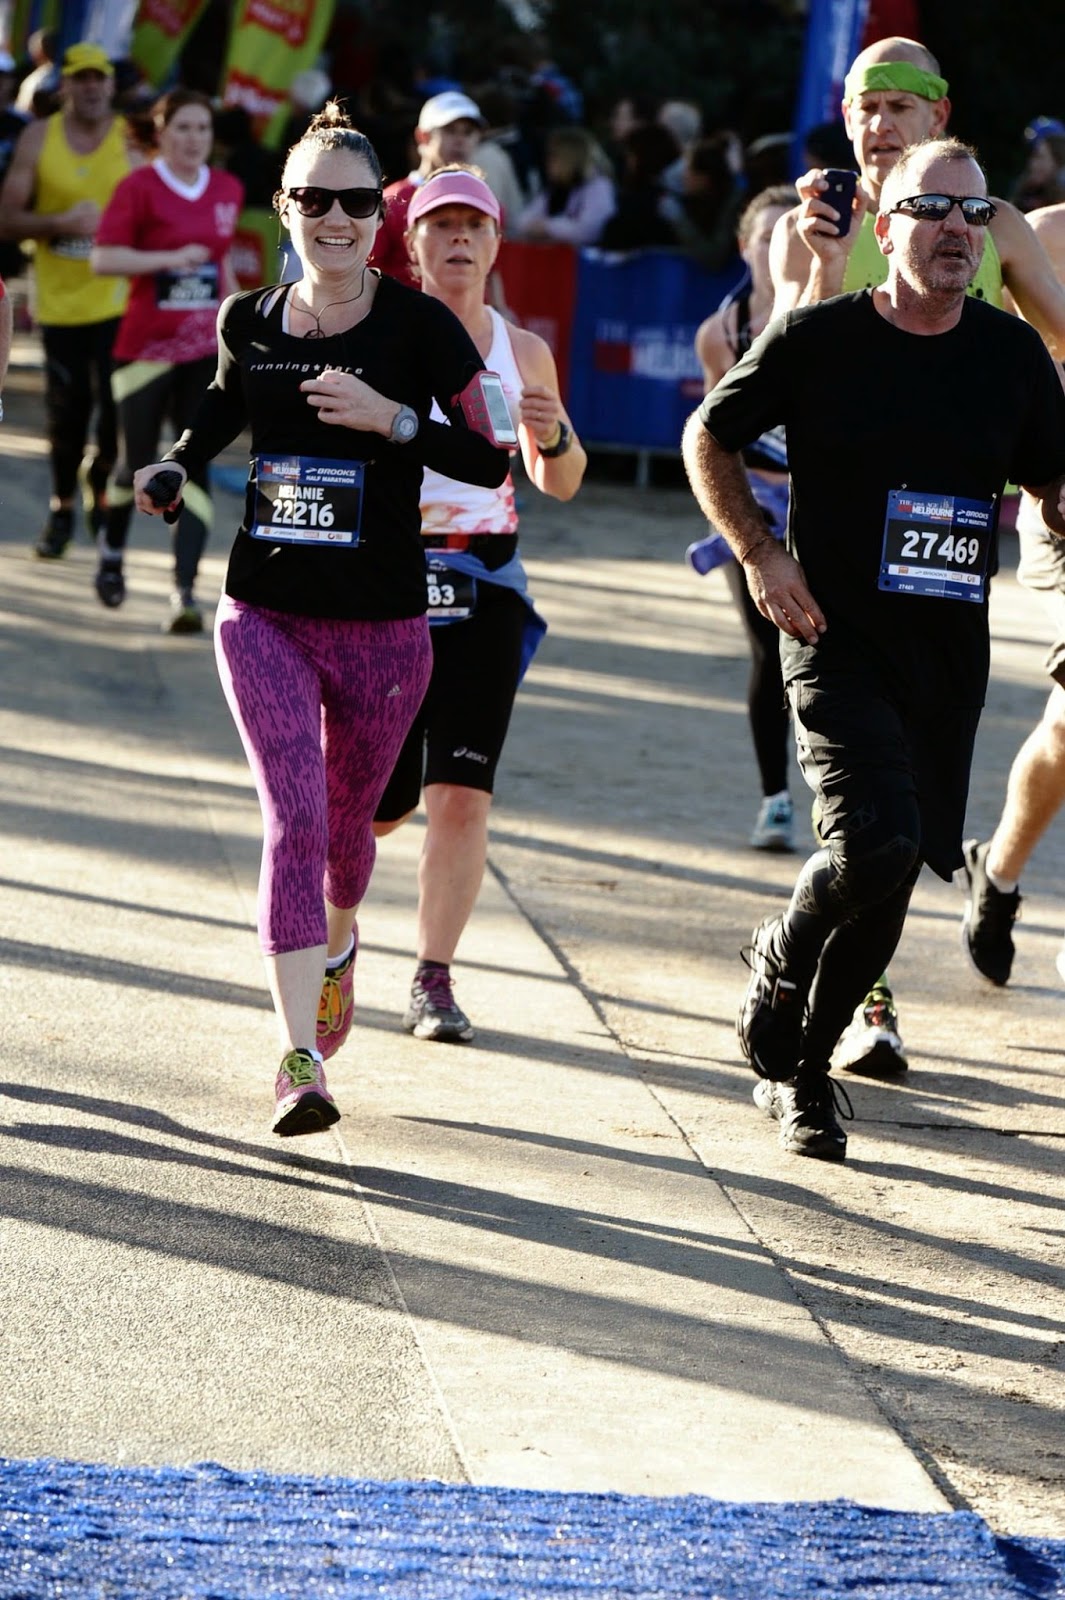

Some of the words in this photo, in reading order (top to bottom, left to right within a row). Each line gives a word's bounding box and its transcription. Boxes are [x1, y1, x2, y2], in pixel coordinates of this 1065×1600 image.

[250, 361, 311, 372] running
[317, 468, 356, 476] BROOKS
[321, 476, 355, 484] MARATHON
[278, 484, 324, 500] MELANIE
[271, 499, 334, 527] 22216
[912, 506, 954, 517] MELBOURNE
[966, 510, 989, 519] BROOKS
[901, 530, 979, 565] 27469
